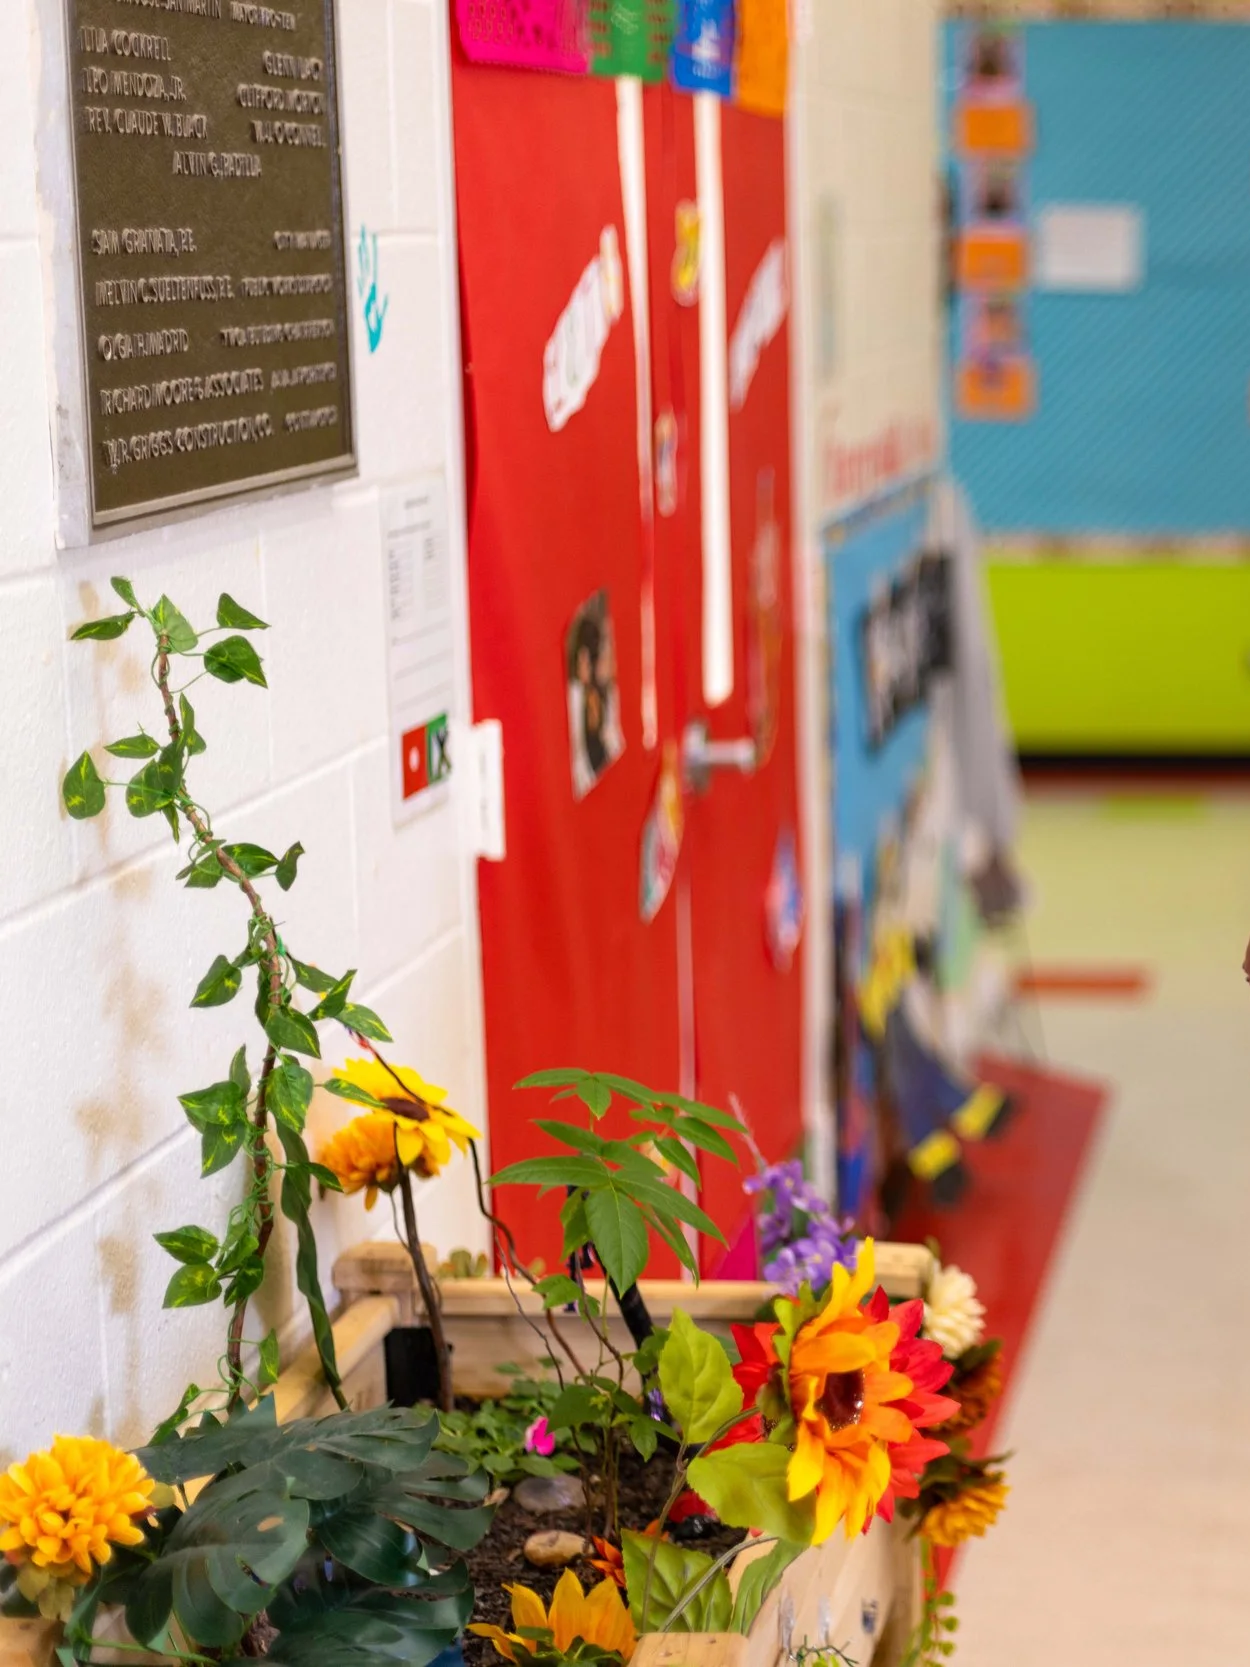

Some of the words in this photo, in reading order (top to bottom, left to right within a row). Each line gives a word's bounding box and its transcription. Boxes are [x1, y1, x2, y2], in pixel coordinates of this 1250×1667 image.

[111, 29, 171, 61] COCKRELL
[82, 66, 108, 95] LEO
[113, 108, 159, 136] CLAUDE
[174, 113, 208, 139] BLACK
[172, 151, 206, 177] ALVIN
[91, 229, 119, 255] SAM
[100, 385, 151, 416] RICHARD
[151, 378, 193, 407] MOORE
